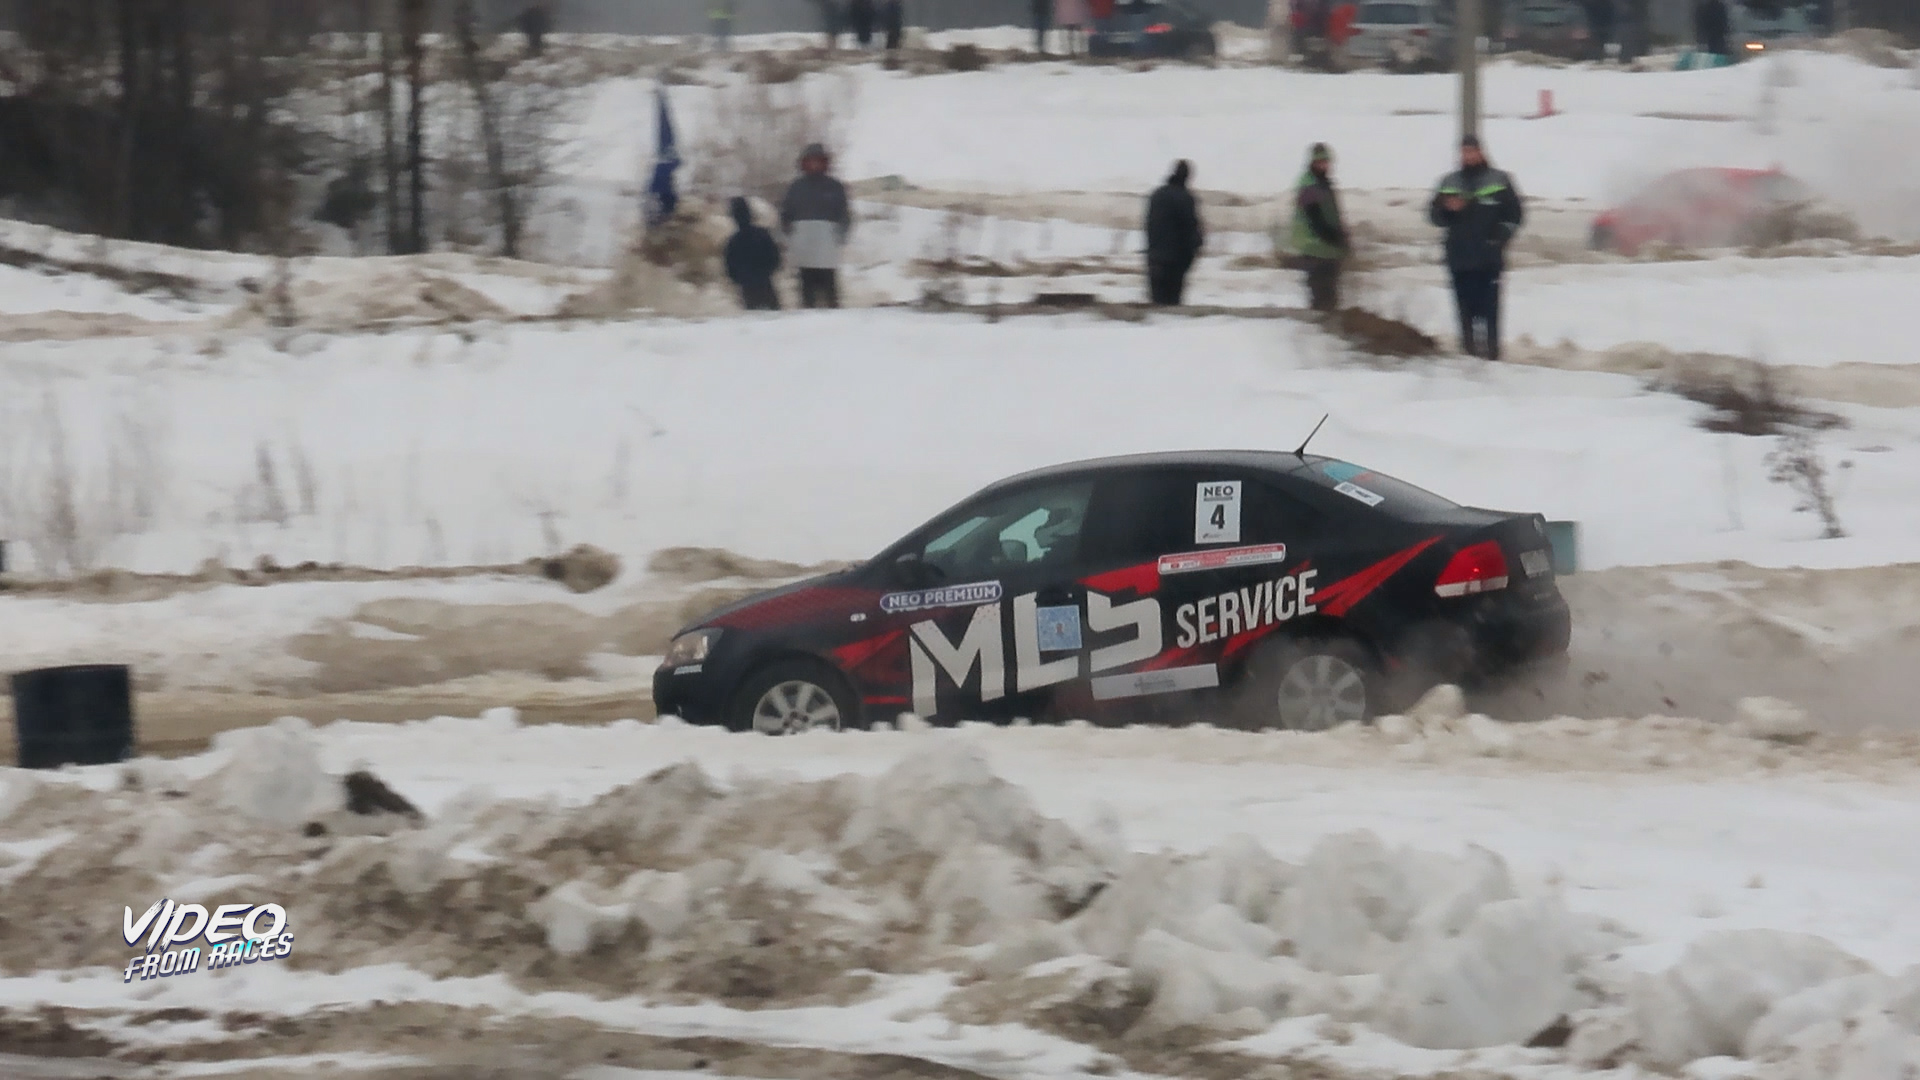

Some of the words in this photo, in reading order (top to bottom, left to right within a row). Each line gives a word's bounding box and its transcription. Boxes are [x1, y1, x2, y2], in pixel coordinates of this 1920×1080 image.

[1203, 486, 1234, 497] NEO
[1210, 504, 1226, 530] 4
[889, 594, 921, 608] NEO
[925, 586, 996, 604] PREMIUM
[909, 590, 1163, 718] MLS
[1176, 569, 1318, 649] SERVICE
